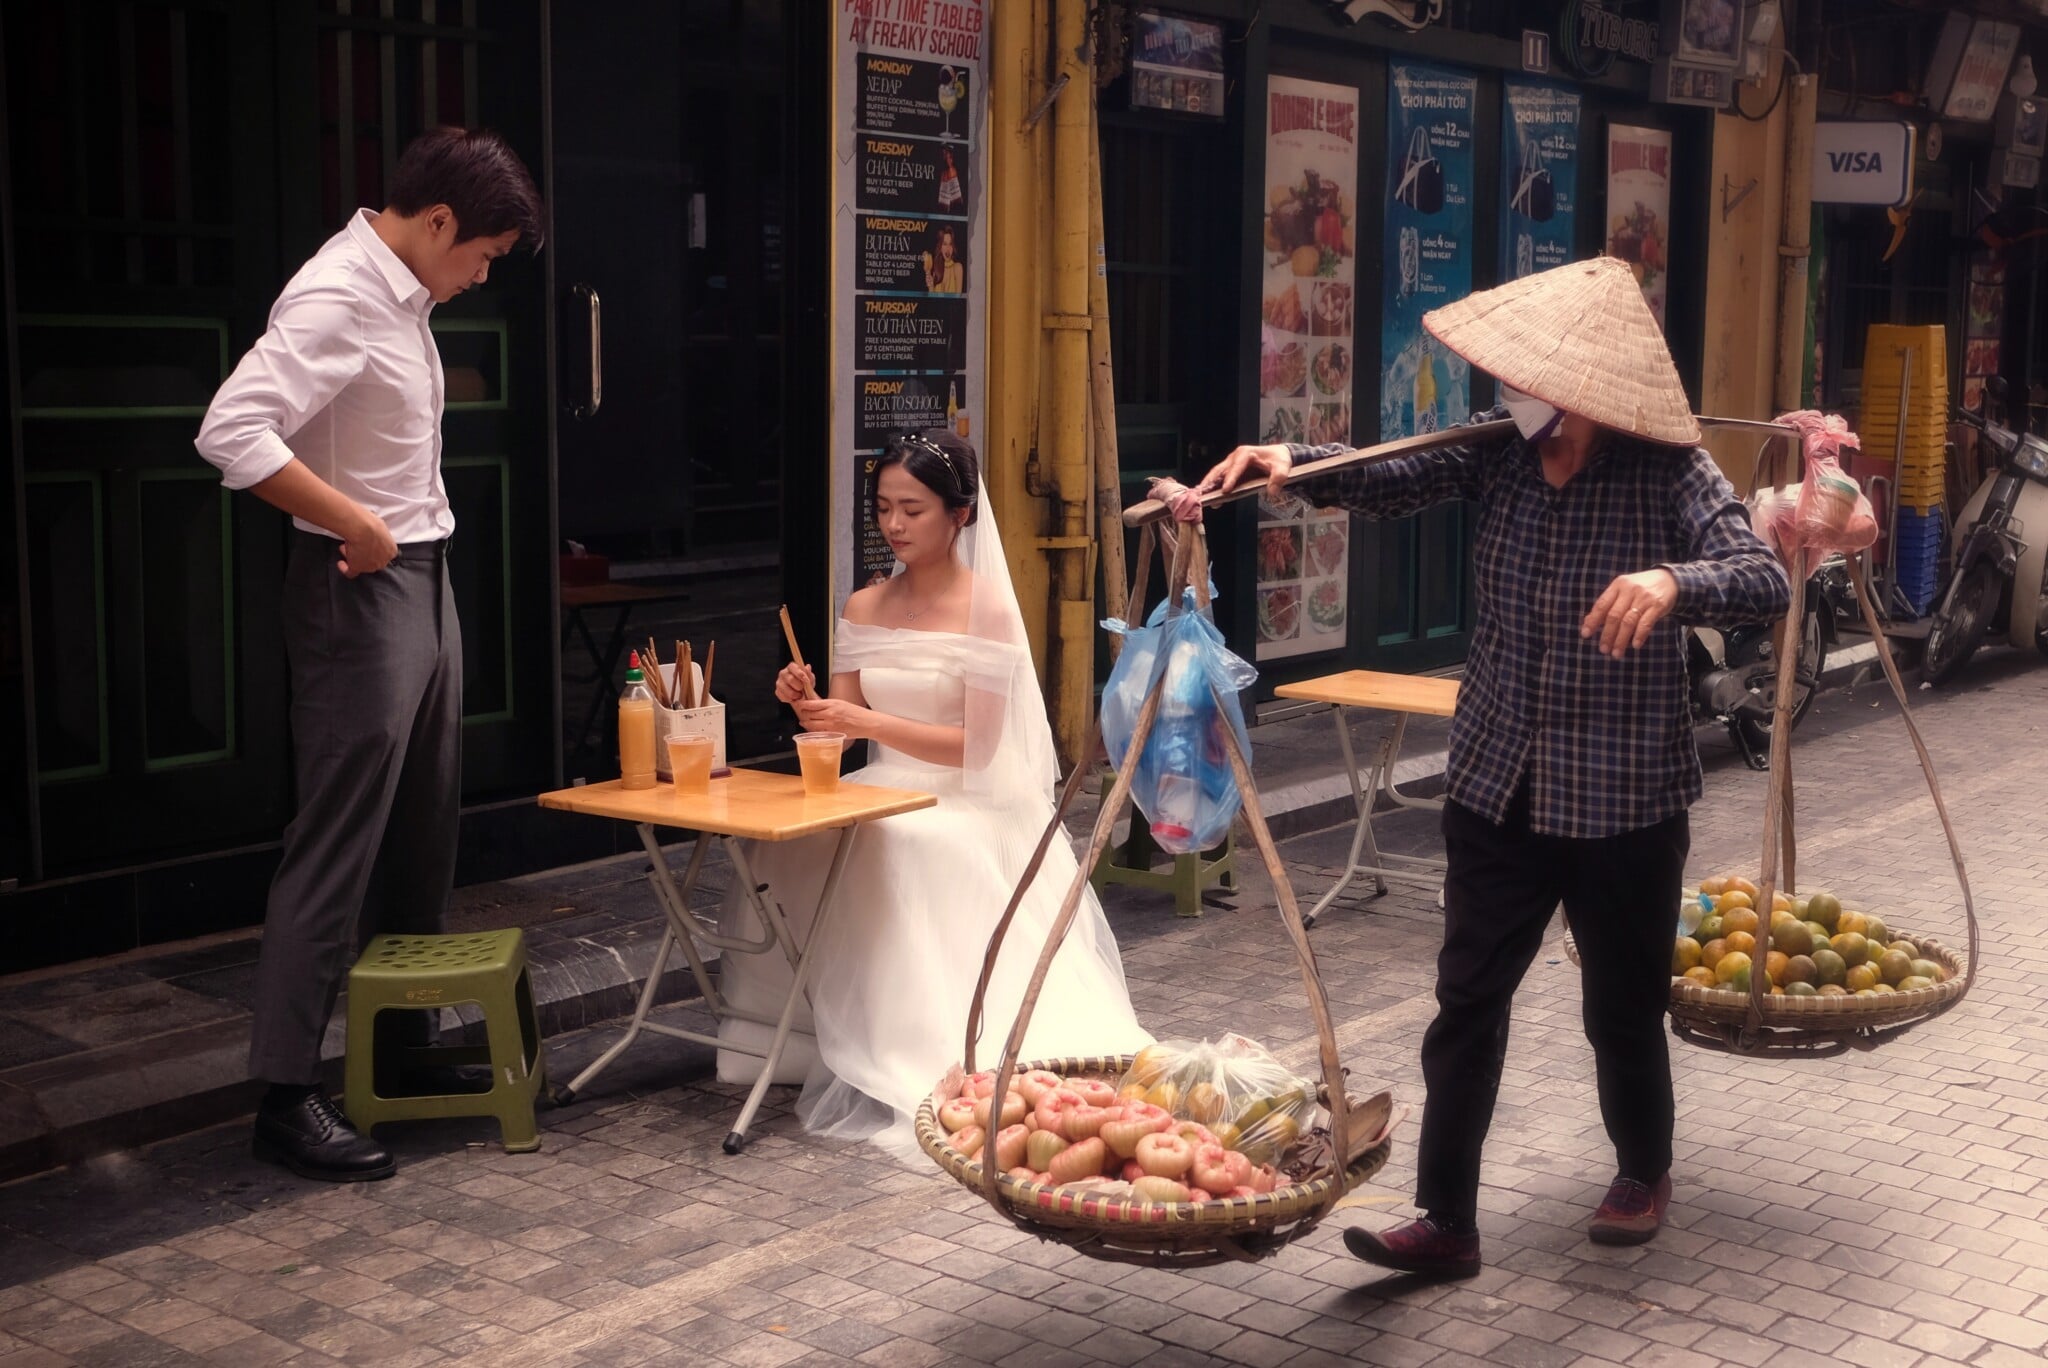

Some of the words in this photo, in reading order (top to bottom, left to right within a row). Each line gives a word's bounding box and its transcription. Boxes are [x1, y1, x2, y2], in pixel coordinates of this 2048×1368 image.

[849, 17, 870, 43] AT
[872, 21, 927, 51] FREAKY
[929, 29, 980, 60] SCHOOL
[1581, 5, 1660, 63] TUBORG
[1528, 37, 1543, 67] 11
[867, 59, 912, 76] MONDAY
[1446, 122, 1456, 136] 12
[865, 140, 914, 156] TUESDAY
[1446, 139, 1461, 148] NGAY
[1555, 136, 1564, 149] 12
[1825, 152, 1882, 172] VISA
[915, 163, 935, 180] BAR
[880, 187, 899, 196] PEARL
[898, 180, 913, 188] BEER
[865, 217, 928, 232] WEDNESDAY
[1437, 234, 1444, 248] 4
[1444, 241, 1456, 249] CHAI
[884, 253, 916, 261] CHAMPAGNE
[865, 301, 918, 314] THURSDAY
[919, 320, 944, 334] TEEN
[865, 381, 904, 394] FRIDAY
[864, 396, 890, 411] BACK
[892, 396, 904, 410] TO
[905, 395, 942, 410] SCHOOL
